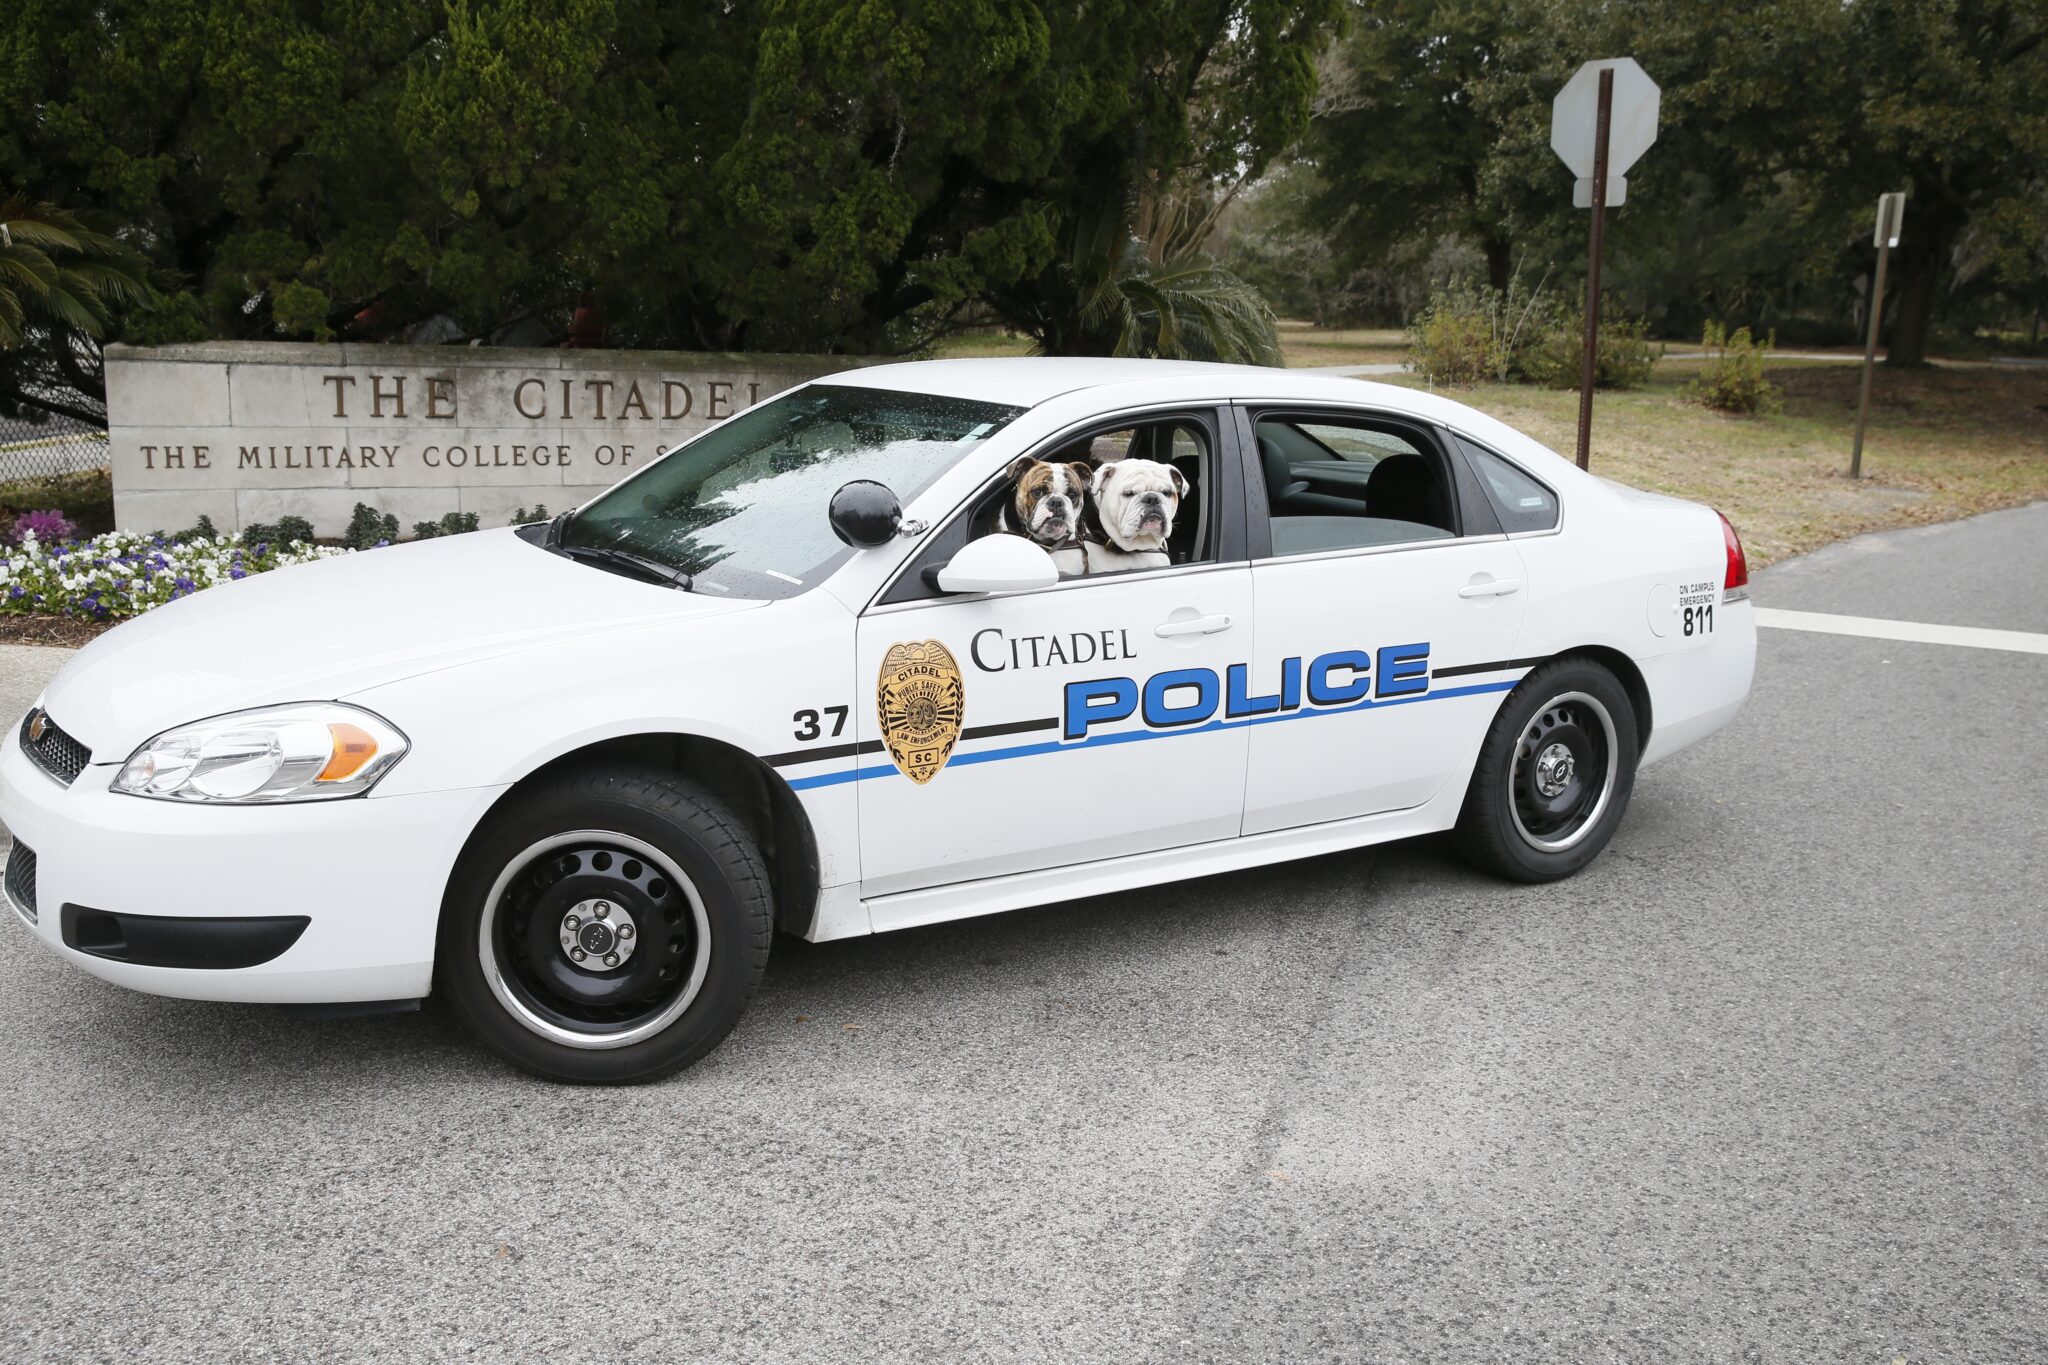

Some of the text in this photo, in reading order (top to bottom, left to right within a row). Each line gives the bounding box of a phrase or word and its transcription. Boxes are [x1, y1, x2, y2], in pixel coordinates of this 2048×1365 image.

[323, 375, 457, 419] THE
[140, 446, 212, 469] THE
[238, 445, 400, 469] MILITARY
[422, 445, 572, 467] COLLEGE
[595, 445, 635, 466] OF
[1680, 582, 1714, 594] ON CAMPUS
[1680, 594, 1714, 606] EMERGENCY
[1684, 605, 1712, 636] 811
[970, 628, 1138, 673] CITADEL
[898, 666, 941, 682] CITADEL
[897, 681, 945, 700] PUBLIC SAFETY
[1063, 642, 1431, 741] POLICE
[793, 705, 850, 741] 37
[897, 725, 948, 744] LAW ENFORCEMENT
